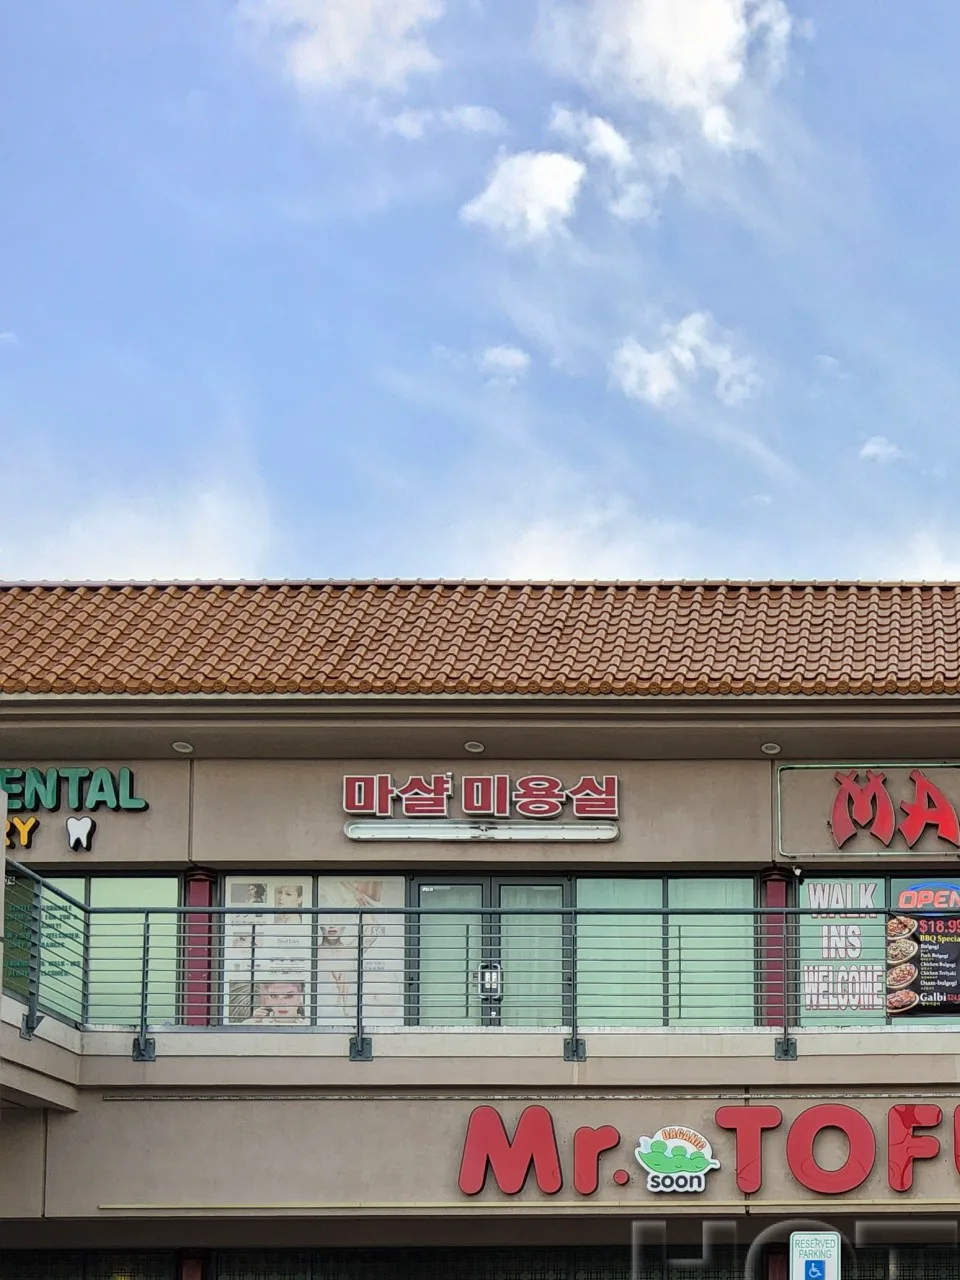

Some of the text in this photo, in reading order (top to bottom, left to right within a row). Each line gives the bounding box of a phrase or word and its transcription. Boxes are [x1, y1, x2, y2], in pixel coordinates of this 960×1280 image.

[343, 773, 619, 818] 마샬 미용실
[807, 882, 877, 919] WALK
[821, 924, 862, 959] INS
[920, 934, 937, 943] BBQ
[803, 965, 884, 1011] WELCOME
[920, 991, 947, 1002] Galbi
[458, 1104, 630, 1195] Mr.
[661, 1127, 706, 1151] ORGANIC
[650, 1174, 703, 1189] soon
[795, 1239, 836, 1249] RESERVED
[799, 1250, 832, 1259] PARKING
